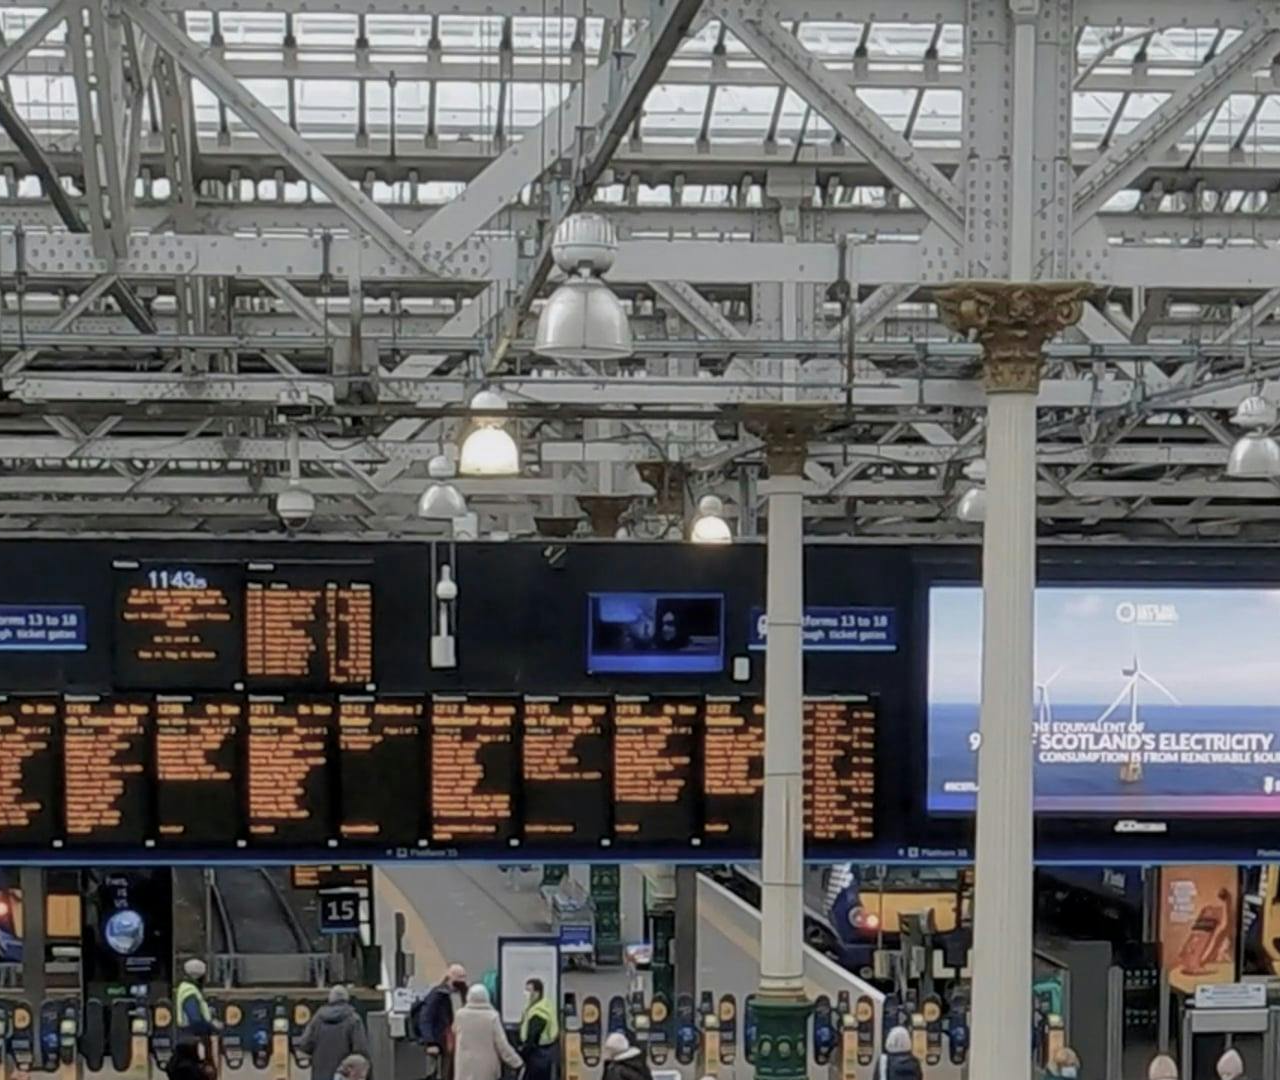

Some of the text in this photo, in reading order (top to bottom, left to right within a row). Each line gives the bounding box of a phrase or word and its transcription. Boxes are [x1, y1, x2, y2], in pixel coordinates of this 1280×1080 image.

[28, 614, 43, 626] 13
[46, 615, 59, 626] to
[62, 615, 77, 626] 18
[841, 616, 855, 627] 13
[858, 616, 870, 627] to
[873, 616, 888, 627] 18
[17, 628, 46, 639] ticket
[48, 630, 76, 641] gates
[829, 630, 857, 640] ticket
[859, 632, 886, 642] gates
[1053, 722, 1126, 734] EQUIVALENT
[1128, 722, 1145, 732] OF
[1040, 732, 1274, 750] SCOTLAND'S ELECTRICITY
[1038, 752, 1128, 762] CONSUMPTION
[1129, 752, 1142, 762] IS
[1144, 752, 1178, 762] FROM
[1180, 752, 1250, 763] RENEWABLE
[328, 900, 355, 920] 15
